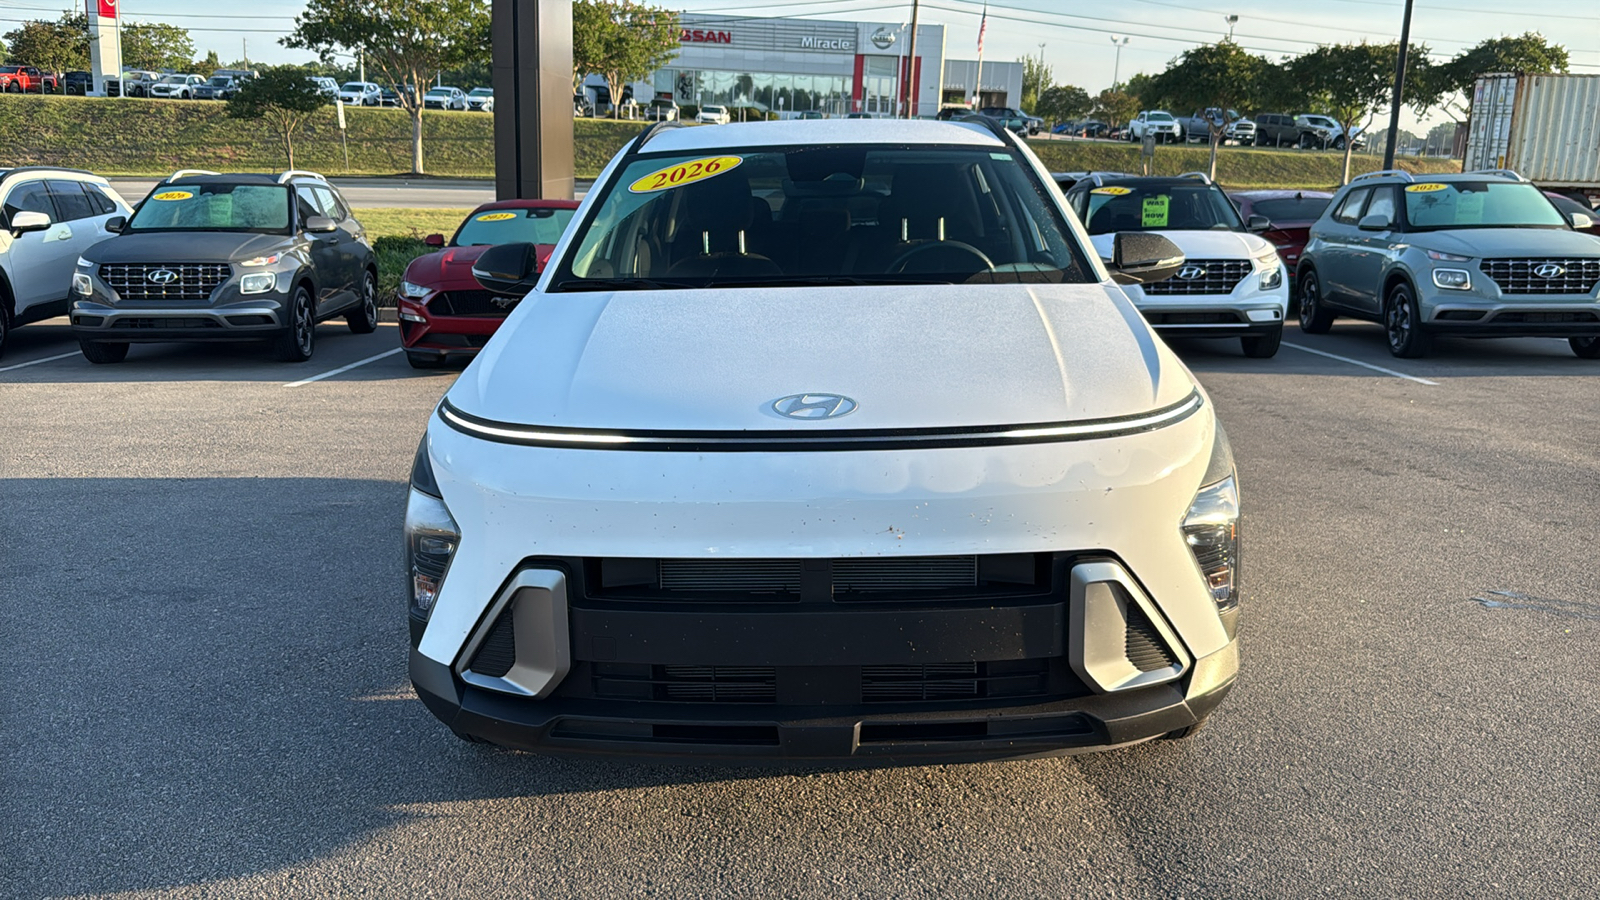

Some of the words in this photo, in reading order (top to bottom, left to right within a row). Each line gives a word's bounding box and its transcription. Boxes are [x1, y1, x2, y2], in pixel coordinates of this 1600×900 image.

[669, 29, 731, 43] SSAN
[801, 36, 850, 50] Miracle
[650, 157, 722, 190] 2026
